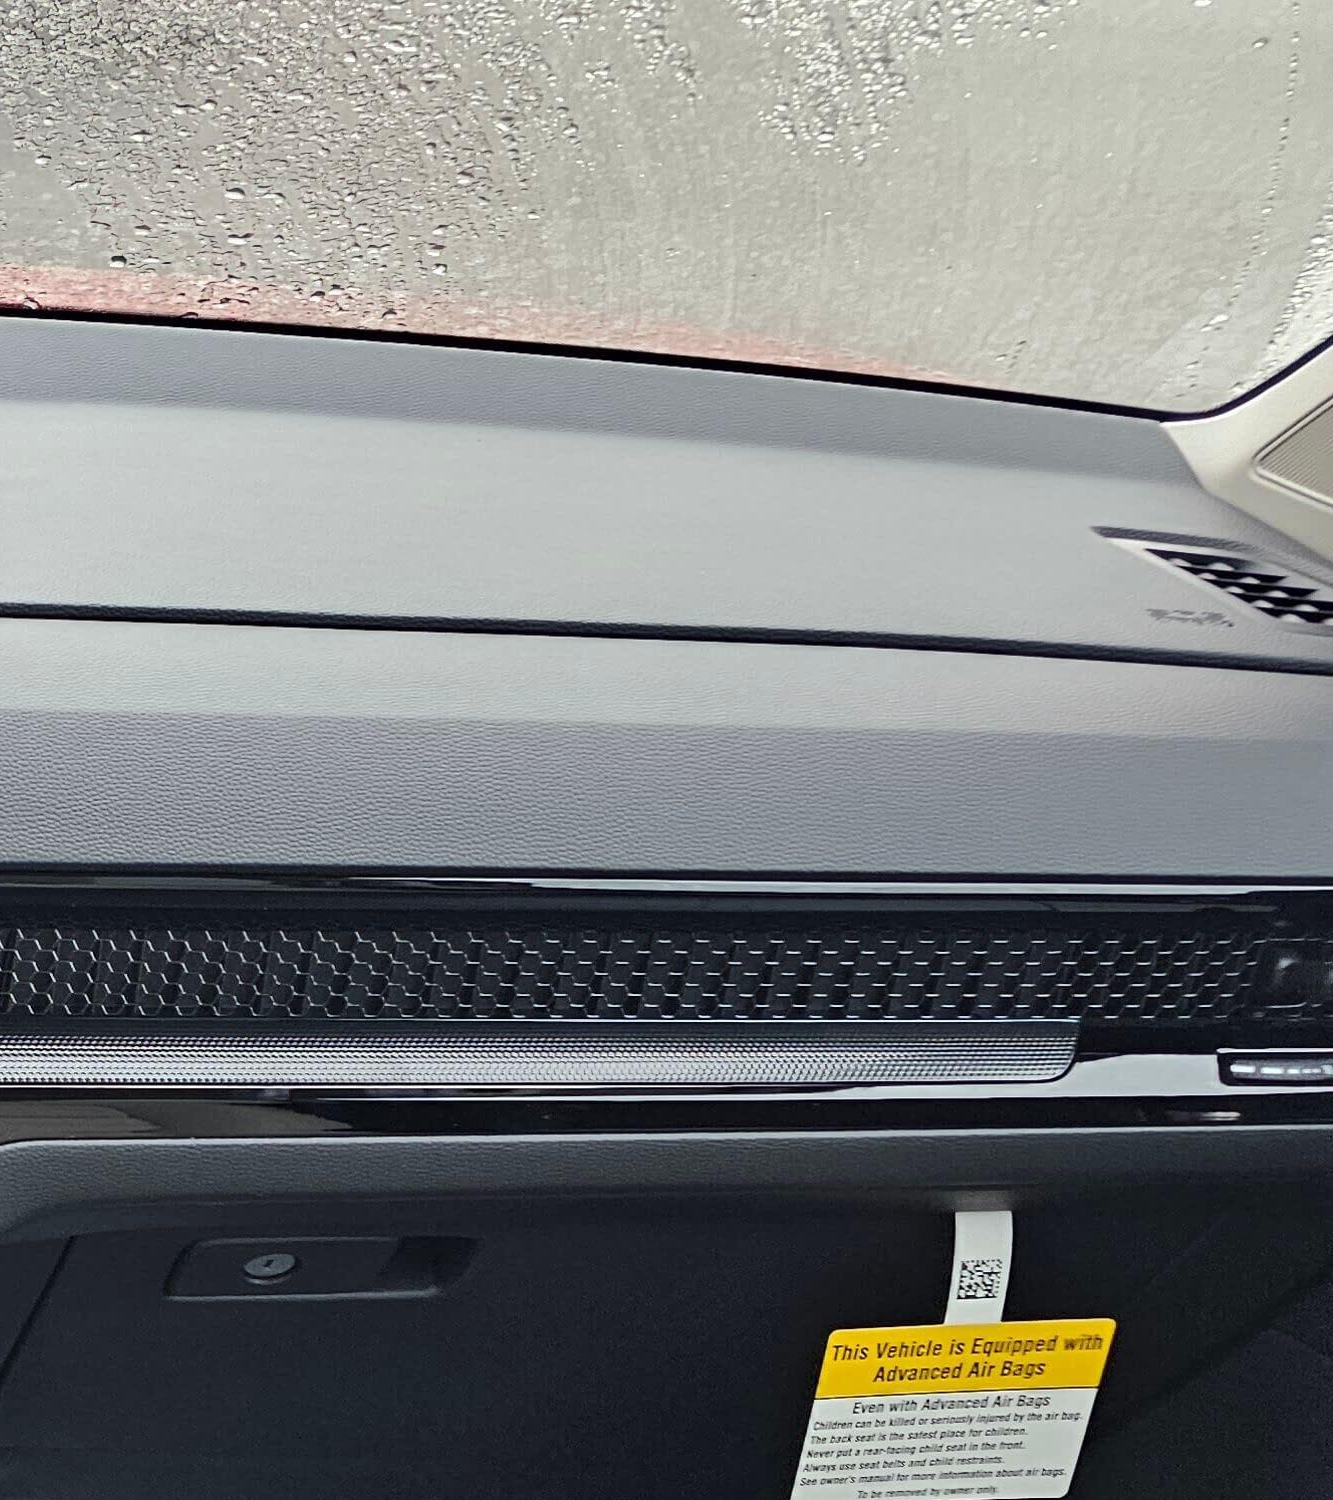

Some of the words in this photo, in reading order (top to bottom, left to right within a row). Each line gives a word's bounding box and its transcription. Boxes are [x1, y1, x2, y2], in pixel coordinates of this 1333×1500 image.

[832, 1344, 870, 1361] This
[876, 1340, 943, 1359] Vehicle
[949, 1339, 965, 1355] is
[970, 1335, 1059, 1357] Equipped
[1064, 1334, 1103, 1350] with
[873, 1362, 963, 1383] Advanced
[967, 1361, 995, 1378] Air
[1000, 1360, 1046, 1379] Bags
[852, 1402, 885, 1414] Even
[889, 1400, 917, 1412] with
[921, 1397, 989, 1411] Advanced
[992, 1395, 1014, 1408] Air
[1016, 1395, 1051, 1409] Bags
[813, 1421, 853, 1431] Children
[855, 1420, 872, 1428] can
[874, 1419, 886, 1427] be
[918, 1418, 929, 1426] or
[1013, 1412, 1024, 1422] by
[1027, 1412, 1043, 1421] the
[1045, 1411, 1059, 1421] air
[811, 1435, 827, 1445] The
[829, 1435, 852, 1444] back
[806, 1449, 834, 1459] Never
